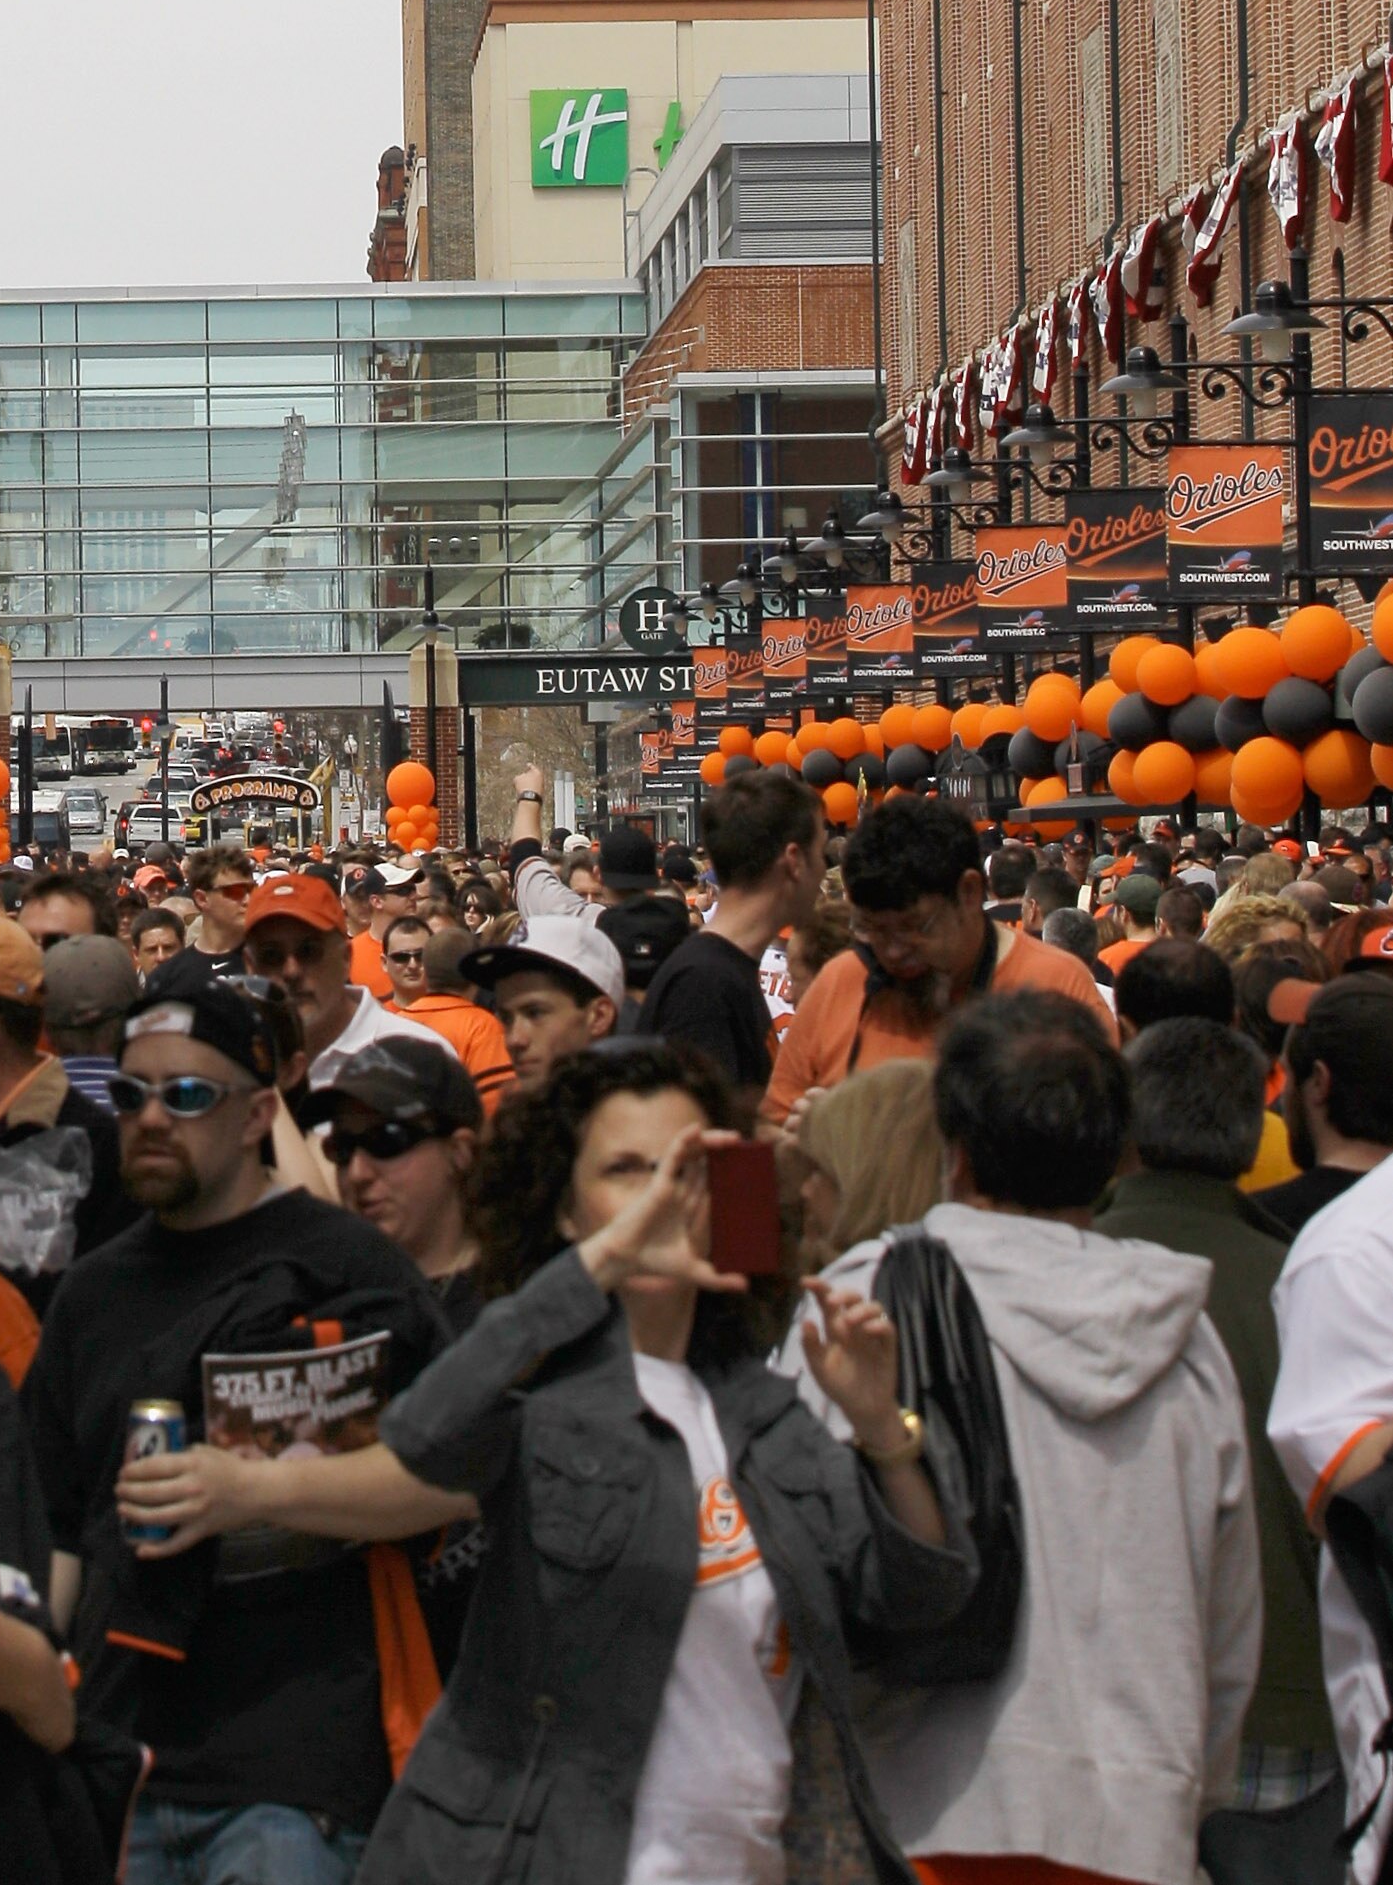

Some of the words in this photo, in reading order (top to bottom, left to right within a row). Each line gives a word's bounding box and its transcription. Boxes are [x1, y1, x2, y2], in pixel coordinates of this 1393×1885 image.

[1167, 461, 1285, 520] Orioles
[1066, 504, 1166, 558] Orioles
[1179, 572, 1271, 583] SOUTHWEST.COM
[635, 599, 668, 632] H
[641, 633, 665, 641] GATE
[921, 654, 988, 664] SOUTHWEST.COM
[537, 667, 650, 694] EUTAW
[659, 666, 695, 692] ST
[210, 780, 299, 807] PROGRAMS
